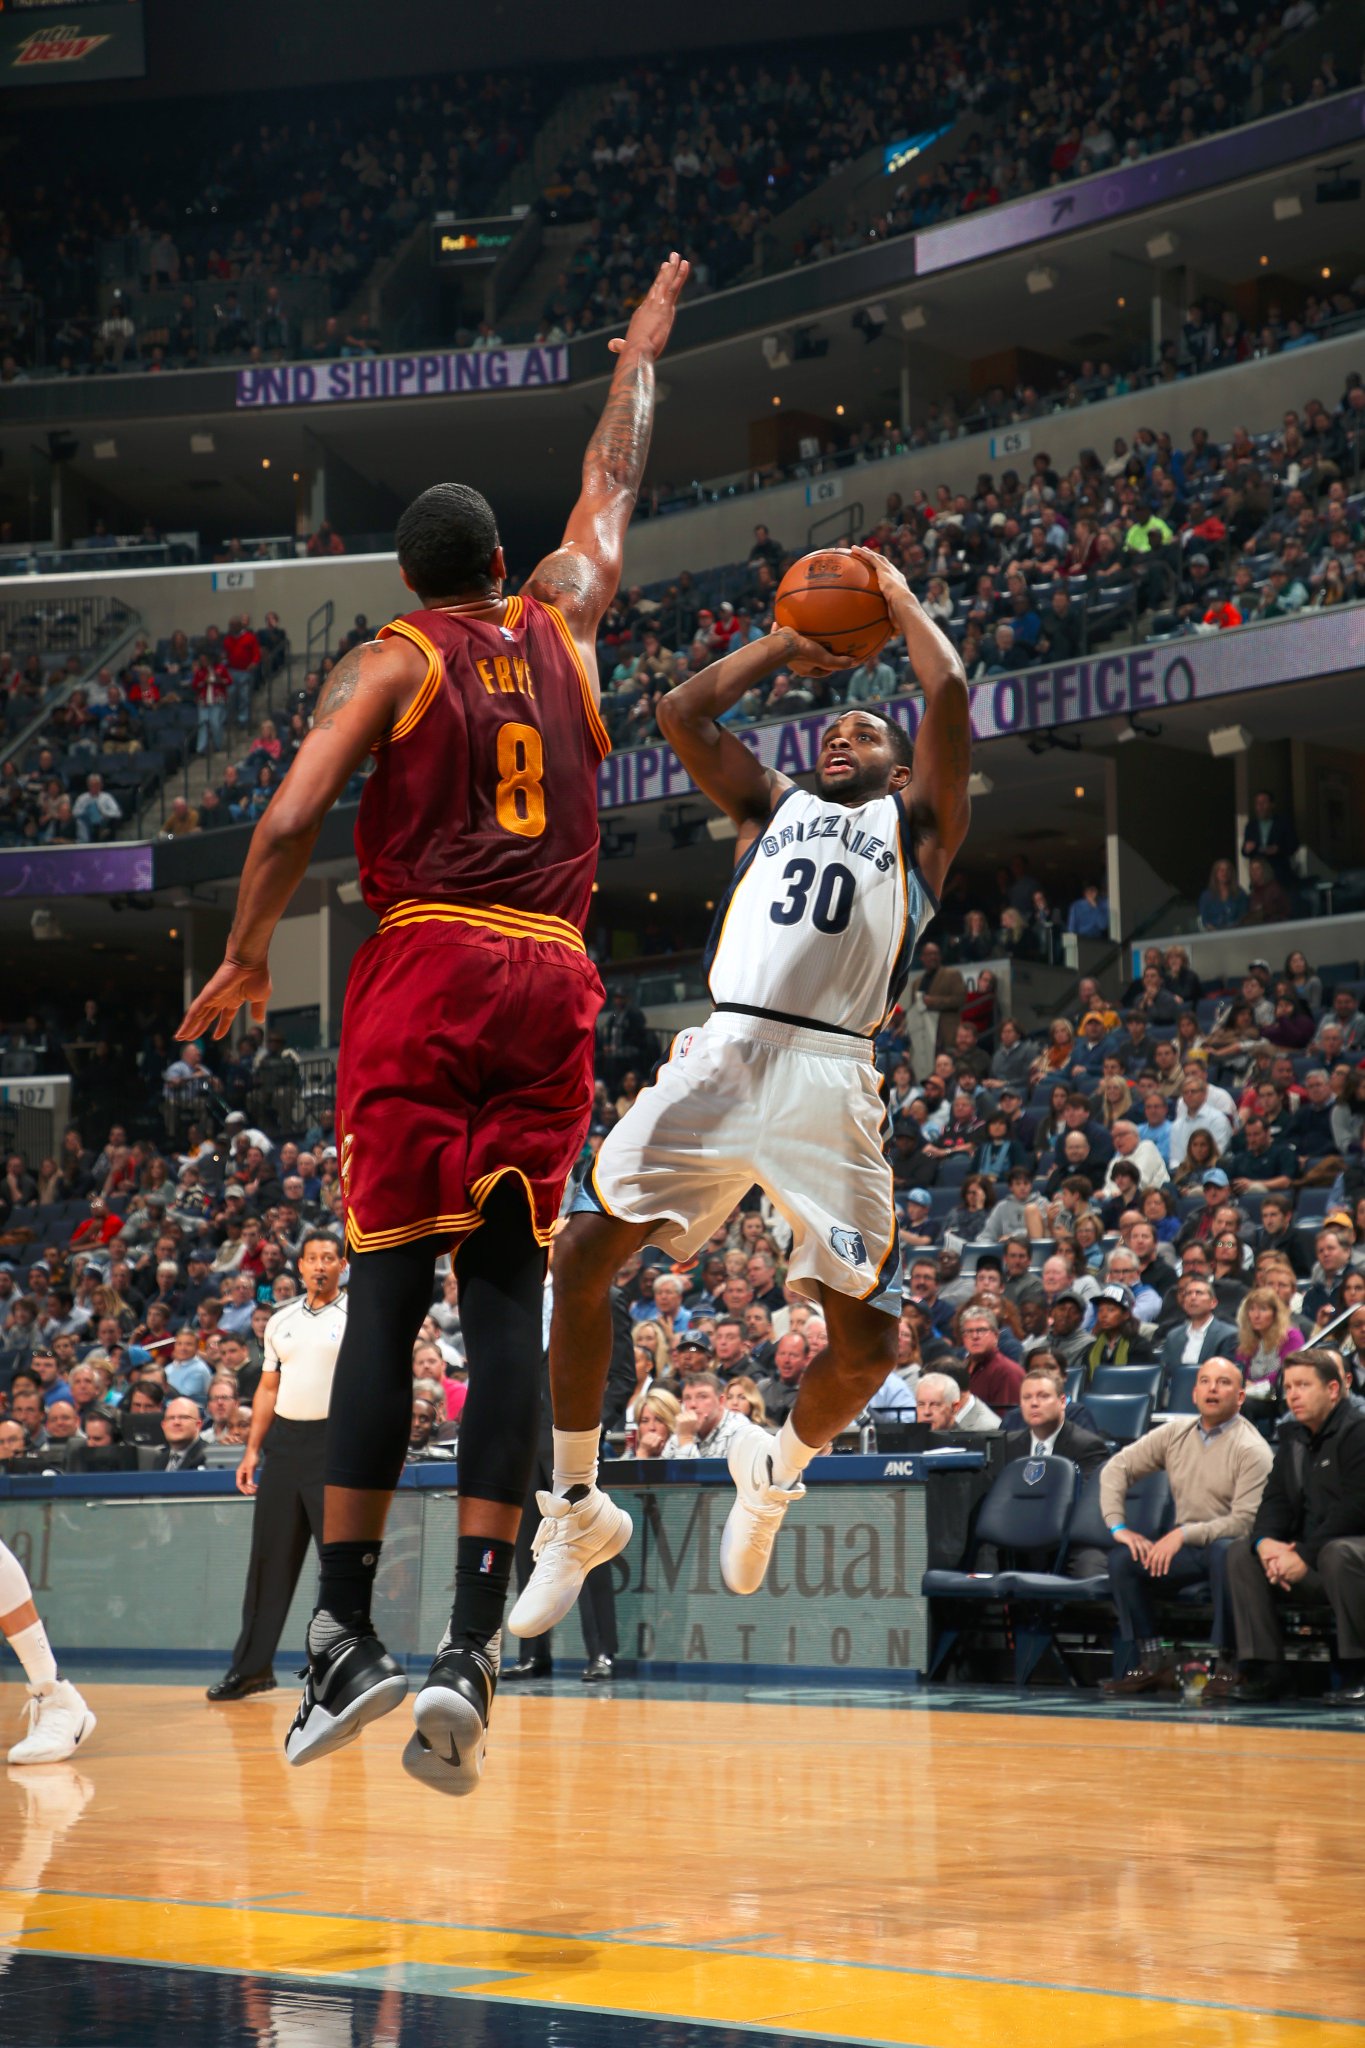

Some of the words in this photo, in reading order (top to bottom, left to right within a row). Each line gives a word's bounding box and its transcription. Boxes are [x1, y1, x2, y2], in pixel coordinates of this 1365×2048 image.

[329, 351, 508, 399] SHIPPING
[522, 345, 569, 384] AT
[475, 655, 536, 700] FRYE
[993, 651, 1157, 730] OFFICE
[496, 722, 546, 837] 8
[761, 815, 895, 872] GRIZZLIES
[770, 858, 856, 935] 30
[884, 1461, 914, 1476] ANC
[637, 1622, 911, 1667] DATION
